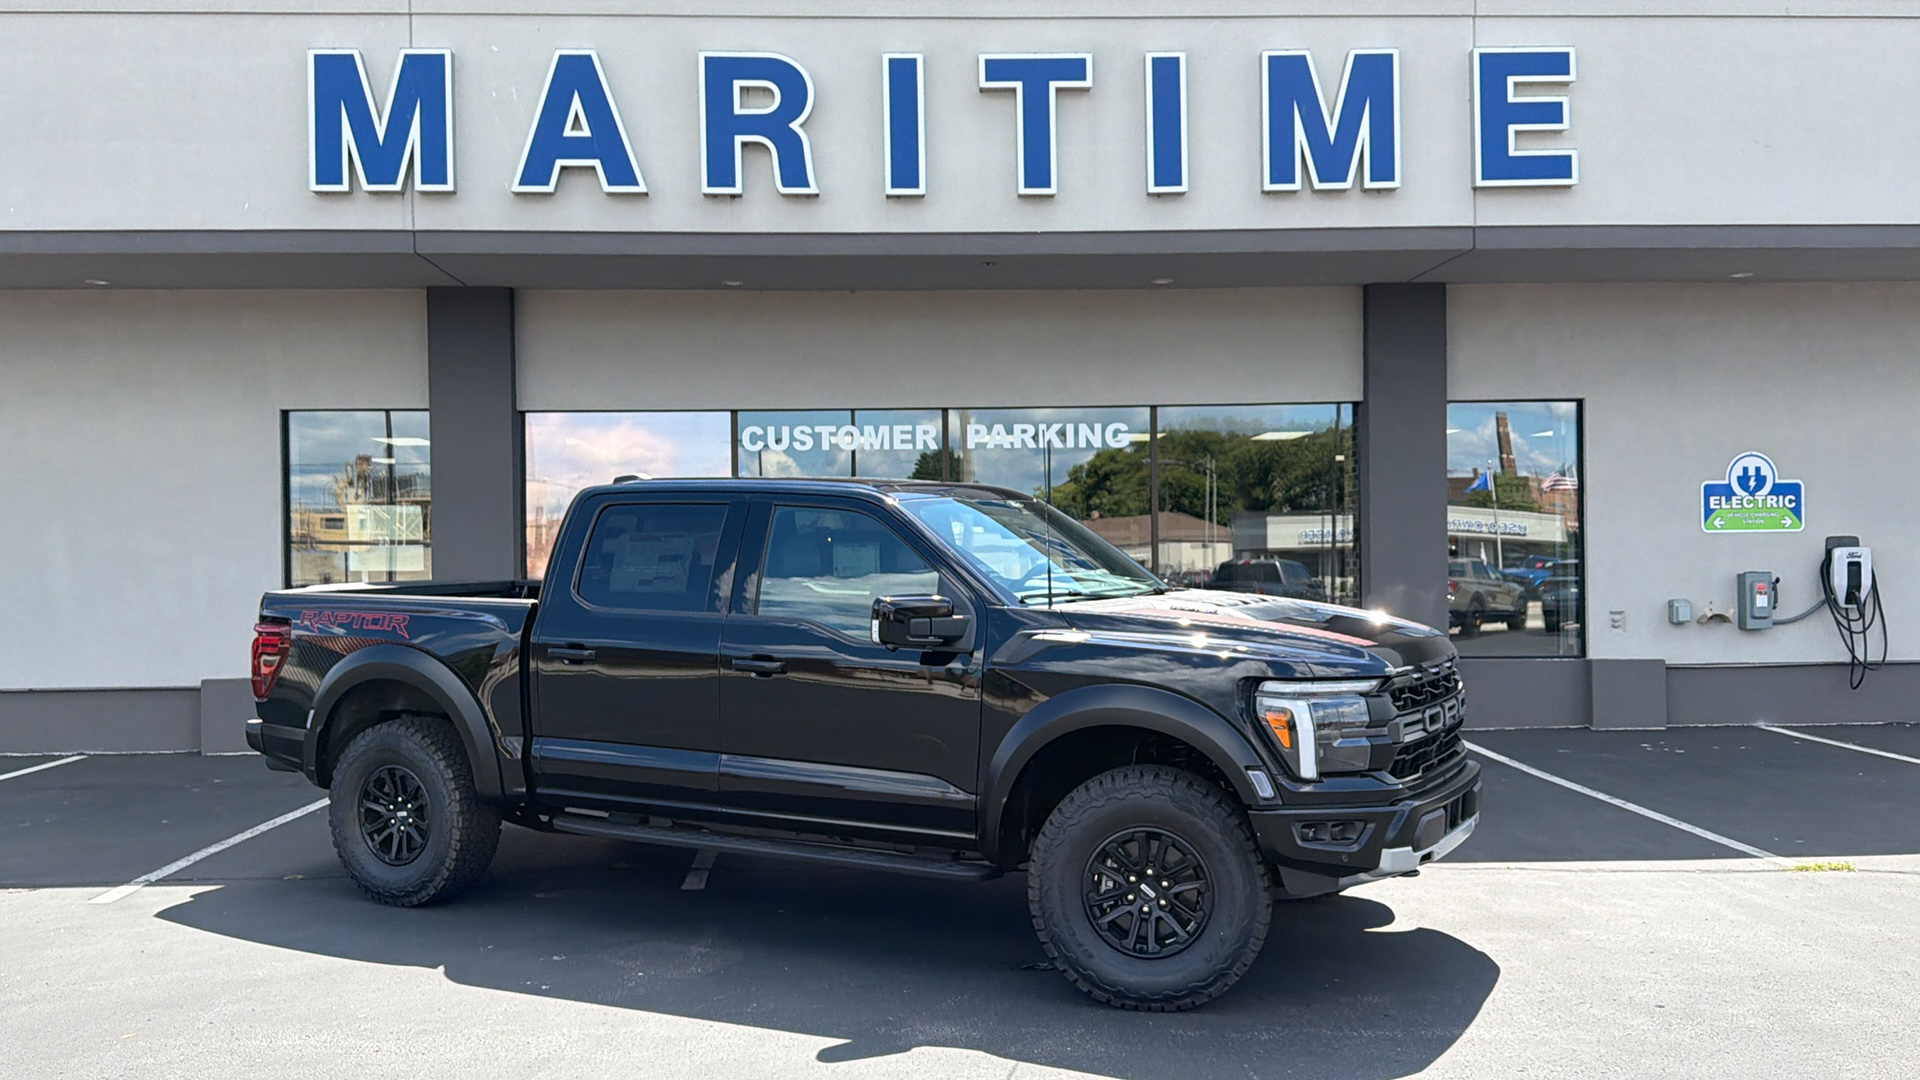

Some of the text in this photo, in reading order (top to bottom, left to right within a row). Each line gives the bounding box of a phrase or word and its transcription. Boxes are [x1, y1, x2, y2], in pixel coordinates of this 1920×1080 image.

[307, 47, 1579, 197] MARITIME
[742, 422, 1131, 451] CUSTOMER PARKING
[1709, 495, 1796, 509] ELECTRIC
[1846, 551, 1862, 559] Ford
[300, 610, 409, 639] RAPTOR
[1398, 689, 1466, 743] FORD
